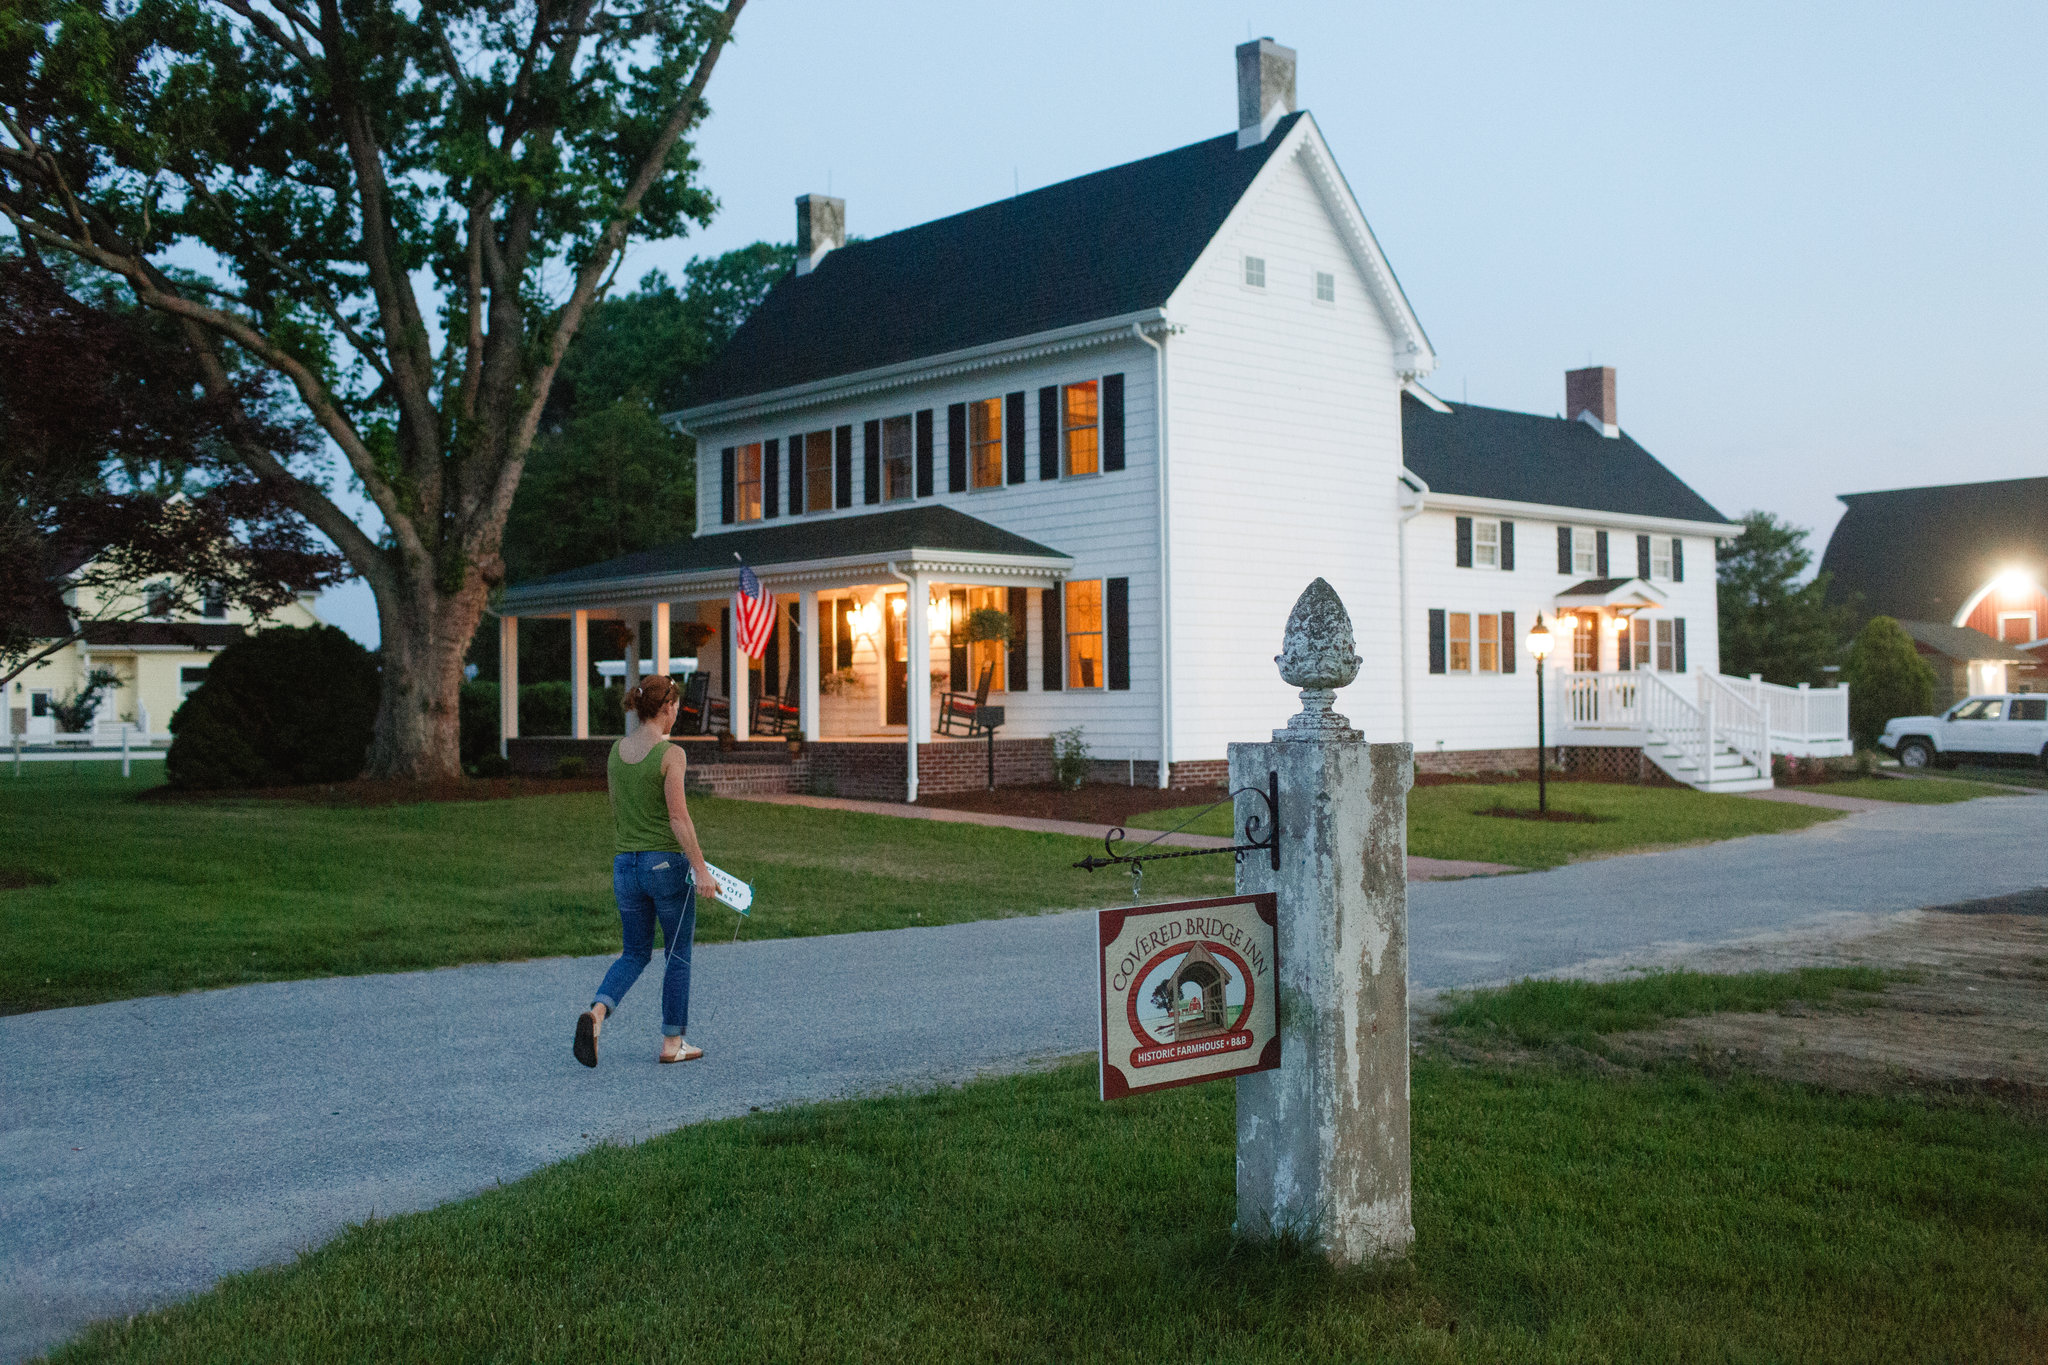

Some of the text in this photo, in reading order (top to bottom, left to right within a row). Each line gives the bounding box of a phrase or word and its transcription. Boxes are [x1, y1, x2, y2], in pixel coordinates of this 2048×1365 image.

[1113, 917, 1268, 992] COVERED BRIDGE INN
[1138, 1036, 1247, 1063] HISTORIC FARMHOUSE B&B
